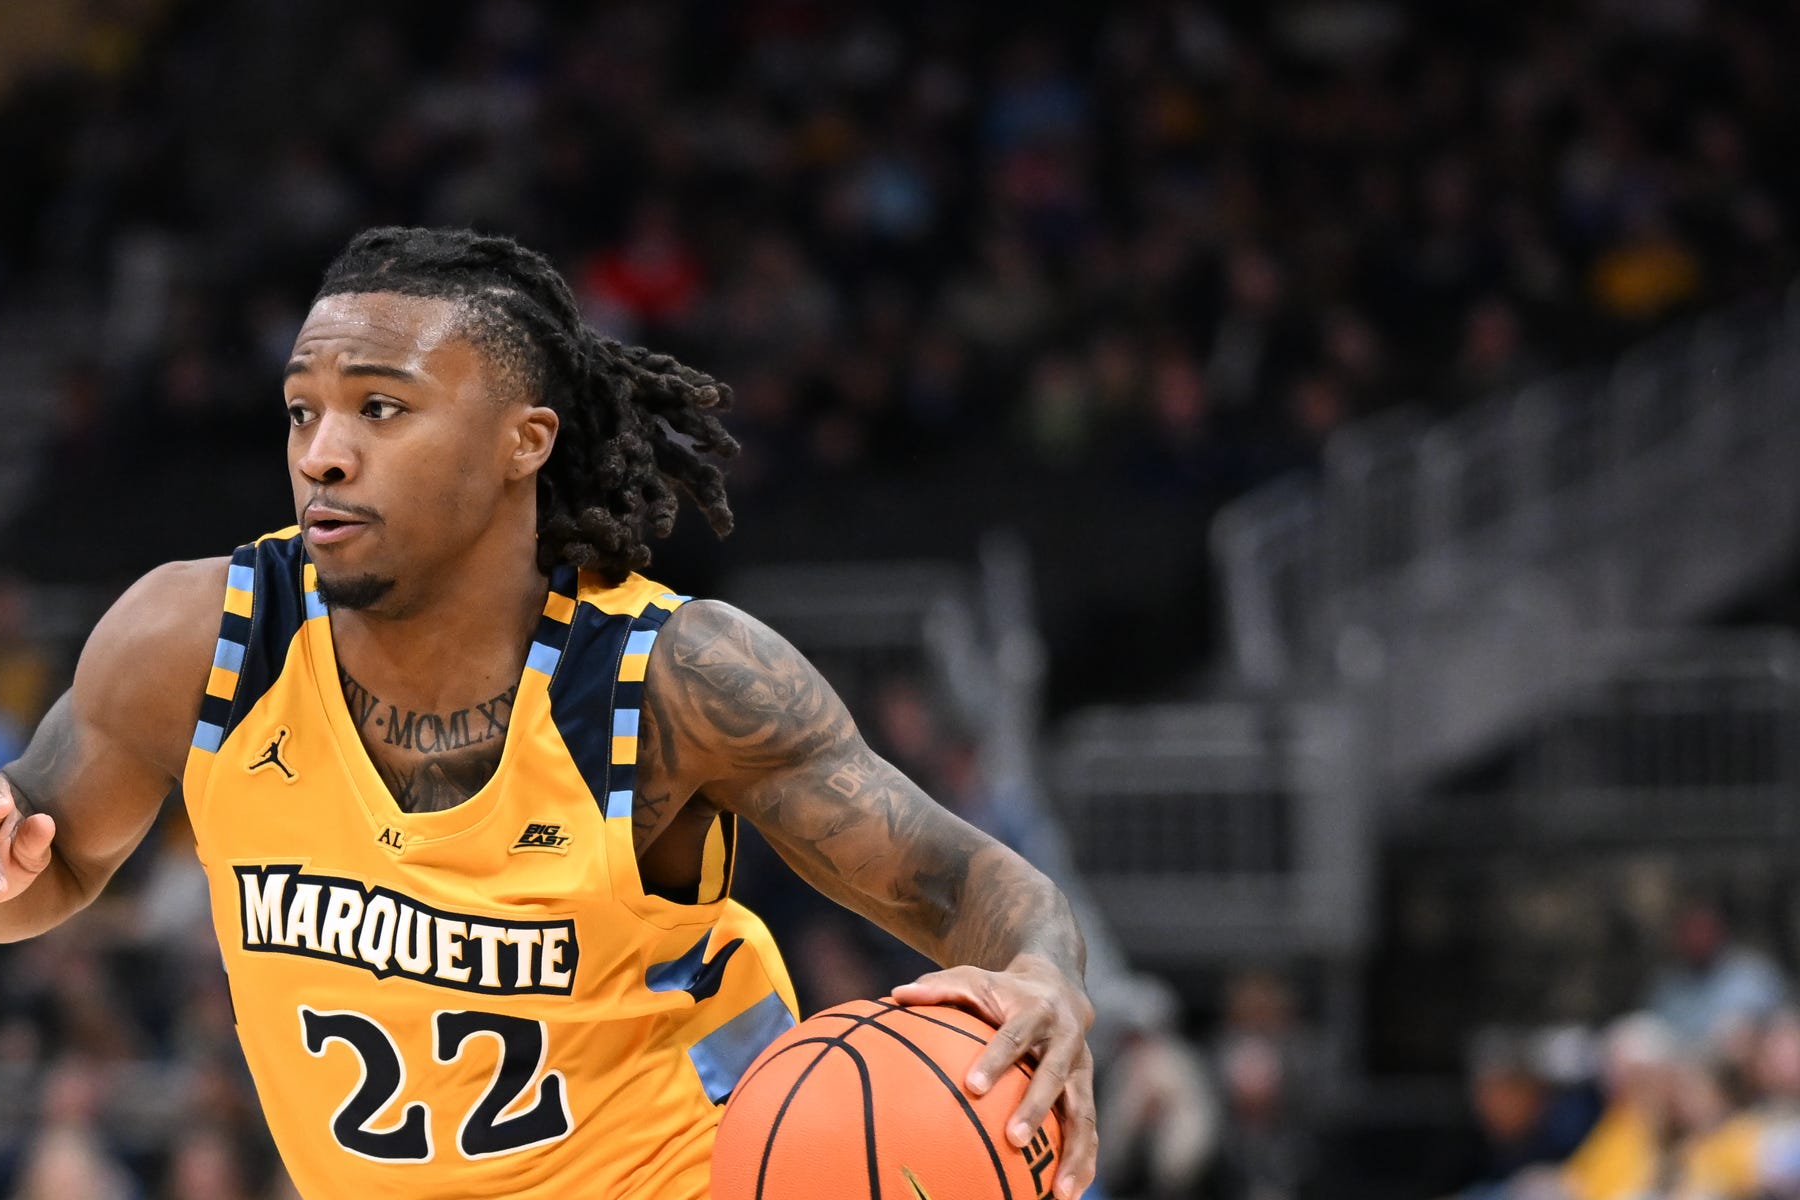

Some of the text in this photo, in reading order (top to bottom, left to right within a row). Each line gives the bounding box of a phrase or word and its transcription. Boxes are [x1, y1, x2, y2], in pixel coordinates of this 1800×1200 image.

[378, 828, 402, 849] AL
[518, 834, 569, 846] EAST
[524, 823, 561, 836] BIG
[240, 872, 573, 988] MARQUETTE
[297, 1004, 575, 1164] 22
